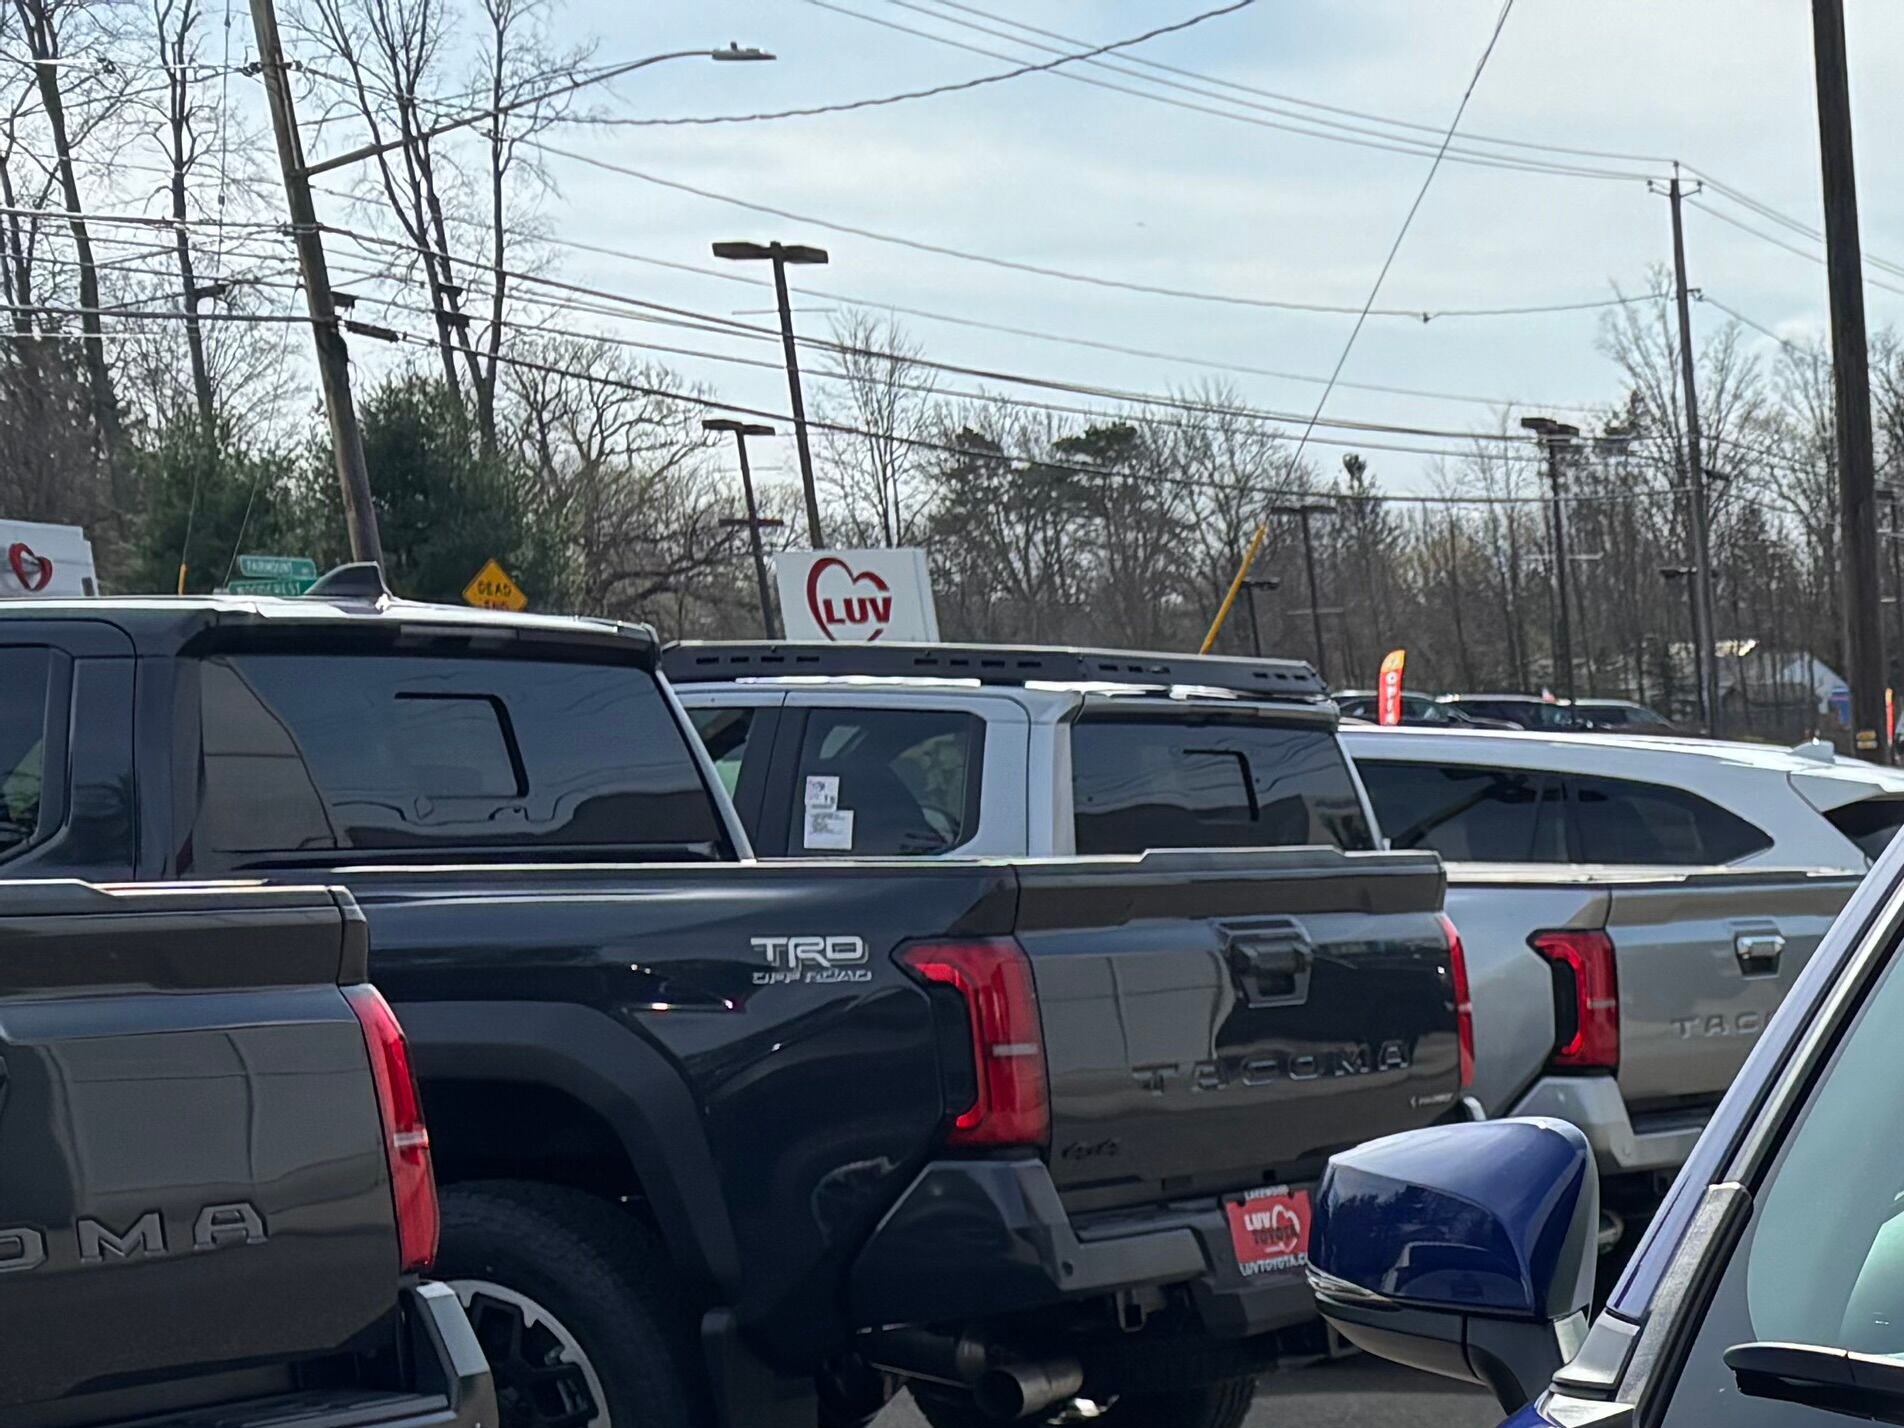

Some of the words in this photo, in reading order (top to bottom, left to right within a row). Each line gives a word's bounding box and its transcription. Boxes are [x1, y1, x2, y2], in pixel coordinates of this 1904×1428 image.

[822, 596, 891, 625] LUV
[750, 936, 868, 968] TRD
[1669, 1012, 1772, 1040] TAC
[1131, 1040, 1410, 1096] TACOMA
[1243, 1211, 1271, 1232] LUV
